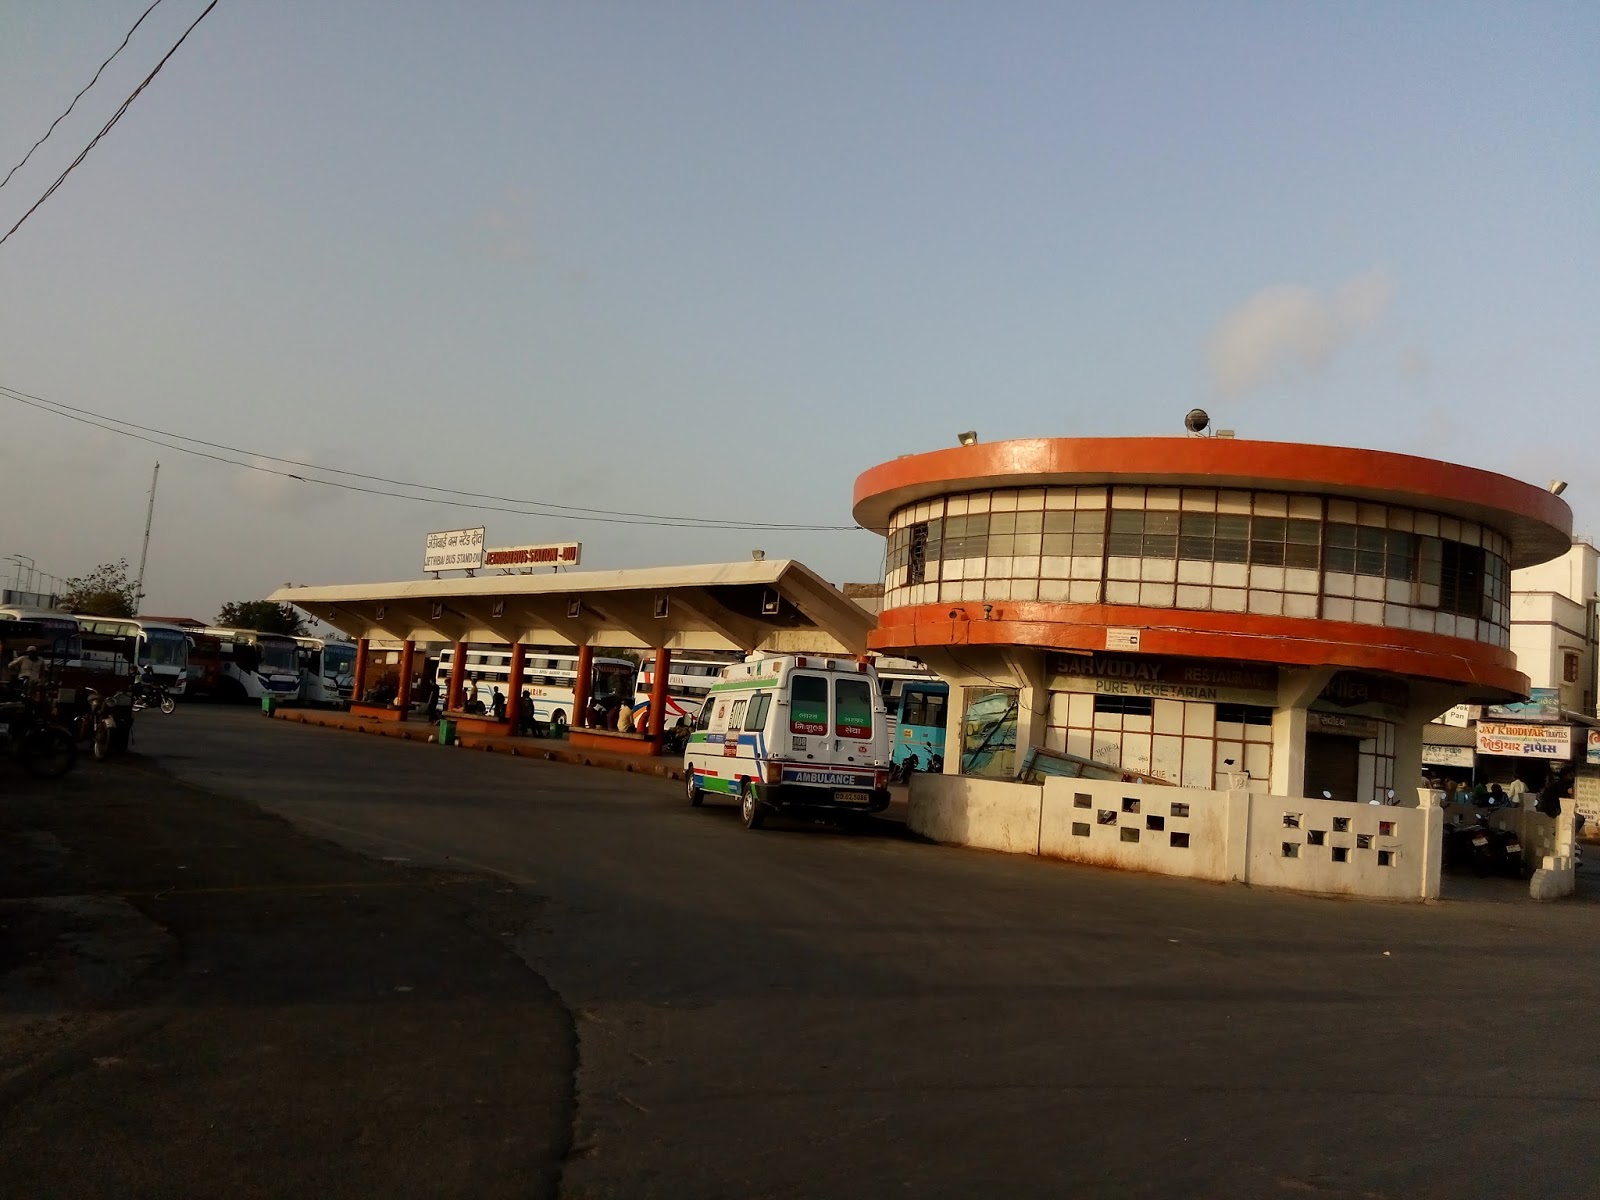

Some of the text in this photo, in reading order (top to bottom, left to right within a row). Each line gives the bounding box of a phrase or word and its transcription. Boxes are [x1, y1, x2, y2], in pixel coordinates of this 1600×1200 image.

[445, 554, 456, 565] BUS
[513, 550, 528, 563] BUS
[528, 548, 558, 562] STATION
[1057, 656, 1163, 680] SARVODAY
[1096, 680, 1217, 699] PURE VEGETARIAN
[1450, 711, 1465, 719] Pan
[1479, 726, 1495, 735] JAY
[796, 772, 856, 785] AMBULANCE
